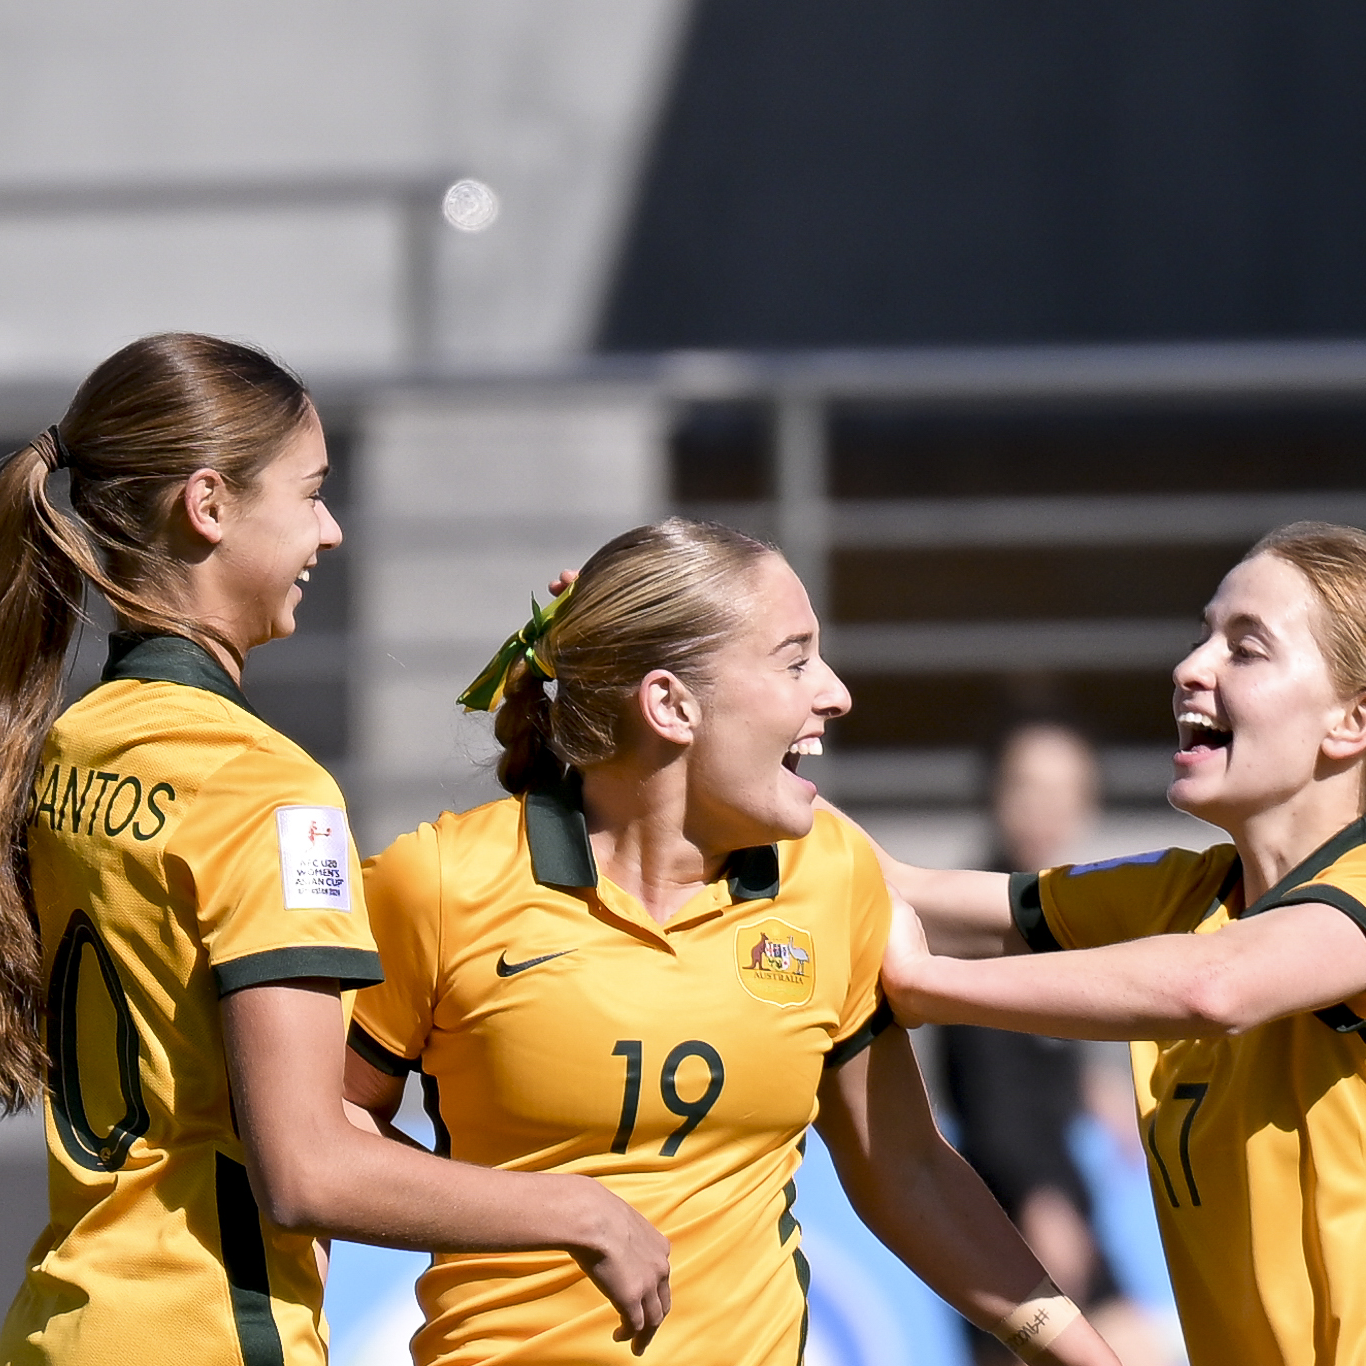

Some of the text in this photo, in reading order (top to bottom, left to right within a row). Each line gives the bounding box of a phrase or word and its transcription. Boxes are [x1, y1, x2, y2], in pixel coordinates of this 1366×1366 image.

[29, 763, 176, 841] ANTOS
[754, 971, 804, 985] AUSTRALIA
[610, 1039, 725, 1158] 19
[1147, 1082, 1210, 1208] 17
